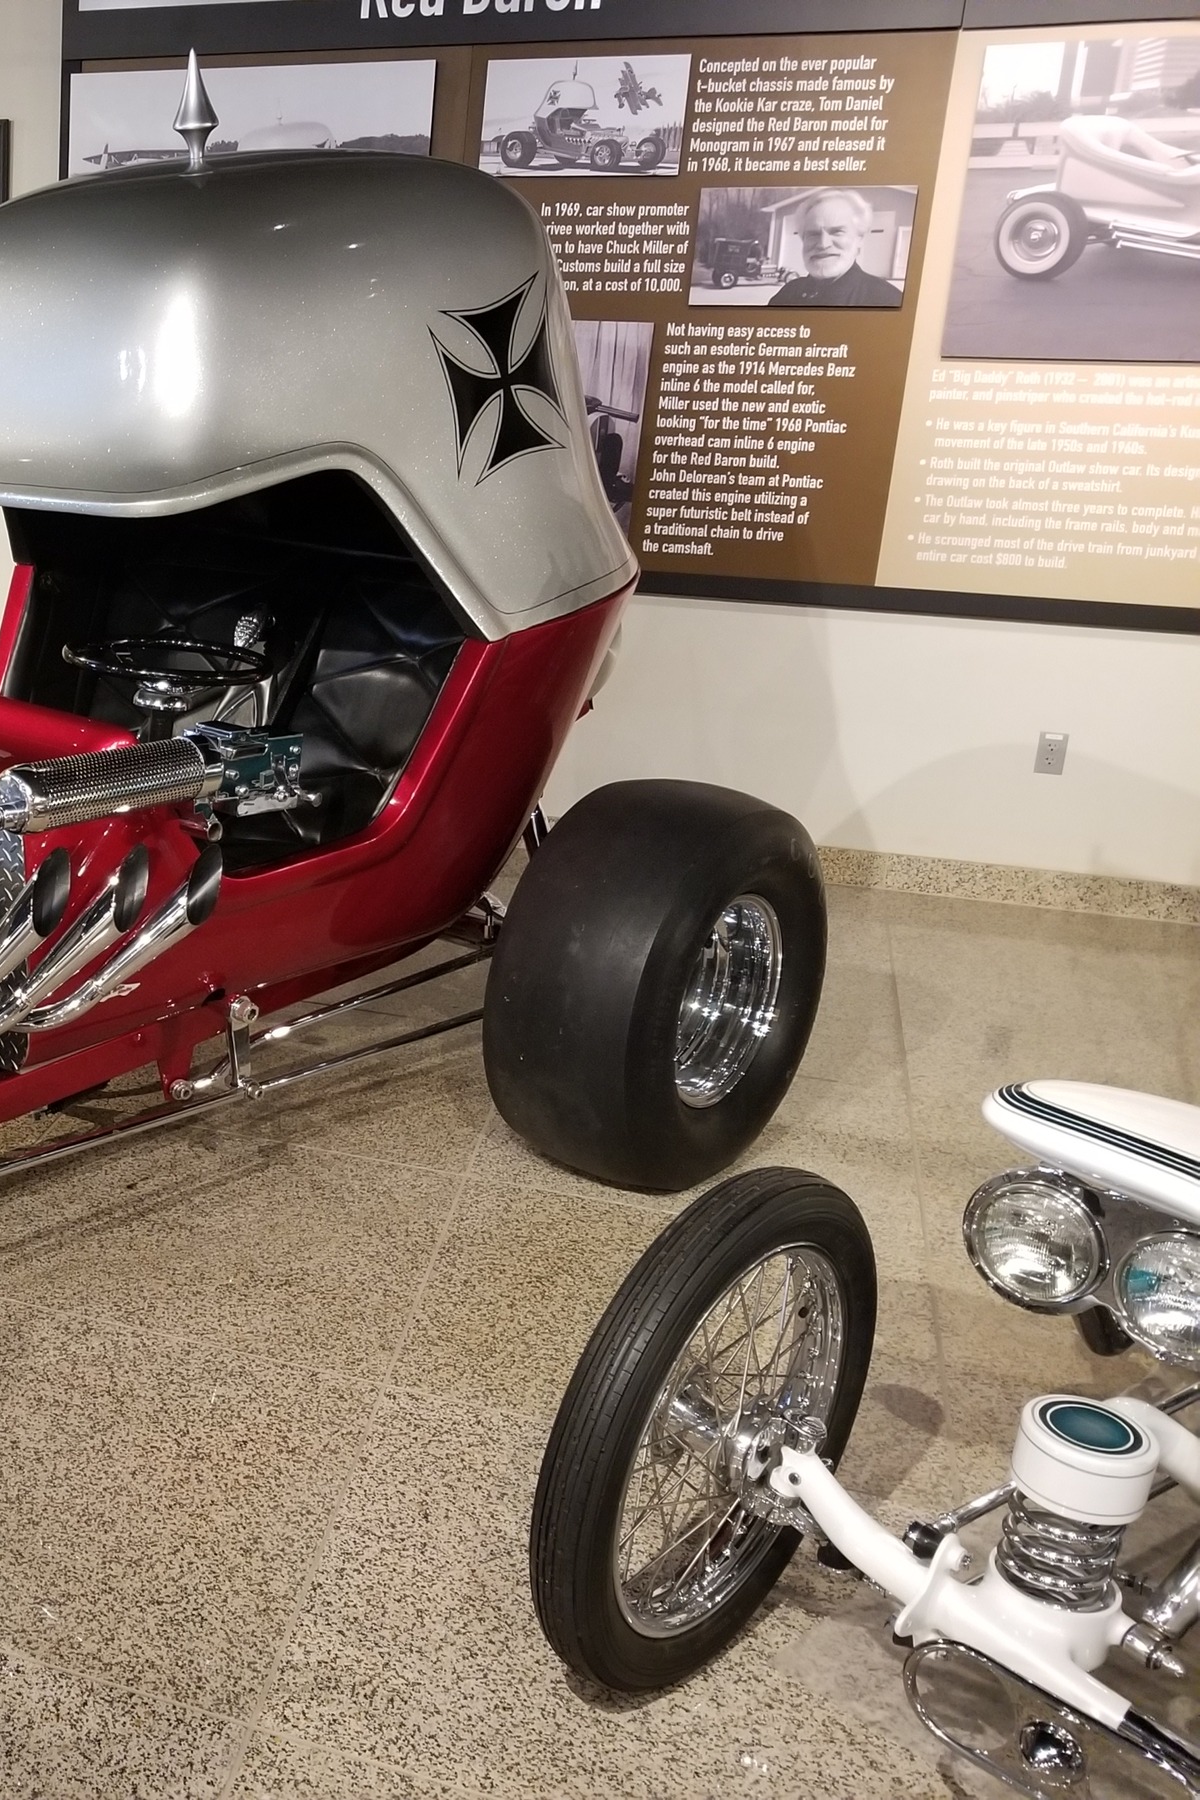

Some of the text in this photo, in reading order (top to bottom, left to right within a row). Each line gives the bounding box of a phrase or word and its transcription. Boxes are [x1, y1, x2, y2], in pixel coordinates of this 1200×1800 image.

[698, 54, 877, 76] Concepted on the ever popular
[696, 74, 895, 93] t-bucket chassis made famous by
[694, 98, 712, 112] the
[714, 97, 754, 112] Kookie
[756, 96, 778, 112] Kar
[819, 95, 842, 111] Tom
[844, 94, 883, 110] Daniel
[691, 115, 888, 136] designed the Red Baron model for
[689, 135, 886, 155] Monogram in 1967 and released it
[686, 156, 698, 171] in
[733, 156, 742, 171] it
[744, 156, 790, 171] became
[792, 159, 801, 171] a
[802, 156, 830, 171] best
[540, 202, 551, 216] In
[585, 205, 604, 216] car
[606, 202, 636, 216] show
[637, 202, 689, 219] promoter
[574, 220, 615, 235] worked
[617, 220, 664, 238] together
[666, 220, 689, 235] with
[564, 240, 575, 253] to
[577, 239, 603, 254] have
[605, 239, 639, 254] Chuck
[642, 239, 674, 254] Miller
[676, 239, 689, 254] of
[603, 258, 631, 272] build
[632, 262, 640, 272] a
[642, 258, 661, 272] full
[662, 258, 685, 273] size
[582, 277, 593, 290] at
[594, 280, 602, 291] a
[604, 278, 628, 291] cost
[629, 277, 642, 291] of
[666, 322, 810, 340] Not having easy access to
[664, 340, 848, 358] such an esoteric German aircraft
[662, 359, 856, 377] engine as the 1914 Mercedes Benz
[660, 377, 690, 391] inline
[692, 378, 700, 392] 6
[702, 378, 720, 392] the
[722, 379, 758, 393] model
[760, 379, 795, 394] called
[658, 395, 826, 414] Miller used the new and exotic
[656, 414, 696, 432] looking
[721, 415, 739, 430] the
[775, 417, 802, 432] 1968
[804, 418, 847, 433] Pontiac
[654, 432, 815, 454] overhead cam inline 6 engine
[652, 450, 668, 463] for
[670, 450, 687, 464] the
[689, 451, 712, 465] Red
[713, 452, 746, 467] Baron
[649, 468, 676, 482] John
[737, 472, 765, 486] team
[767, 473, 780, 487] at
[781, 473, 823, 488] Pontiac
[648, 487, 807, 509] created this engine utilizing a
[646, 504, 810, 524] super futuristic belt instead of
[644, 522, 784, 541] a traditional chain to drive
[642, 538, 659, 552] the
[917, 531, 1197, 560] He scrounged most of the drive train from junkyard
[916, 548, 947, 562] entire
[949, 553, 968, 562] car
[969, 552, 993, 564] cost
[994, 551, 1023, 566] $800
[1023, 554, 1035, 566] to
